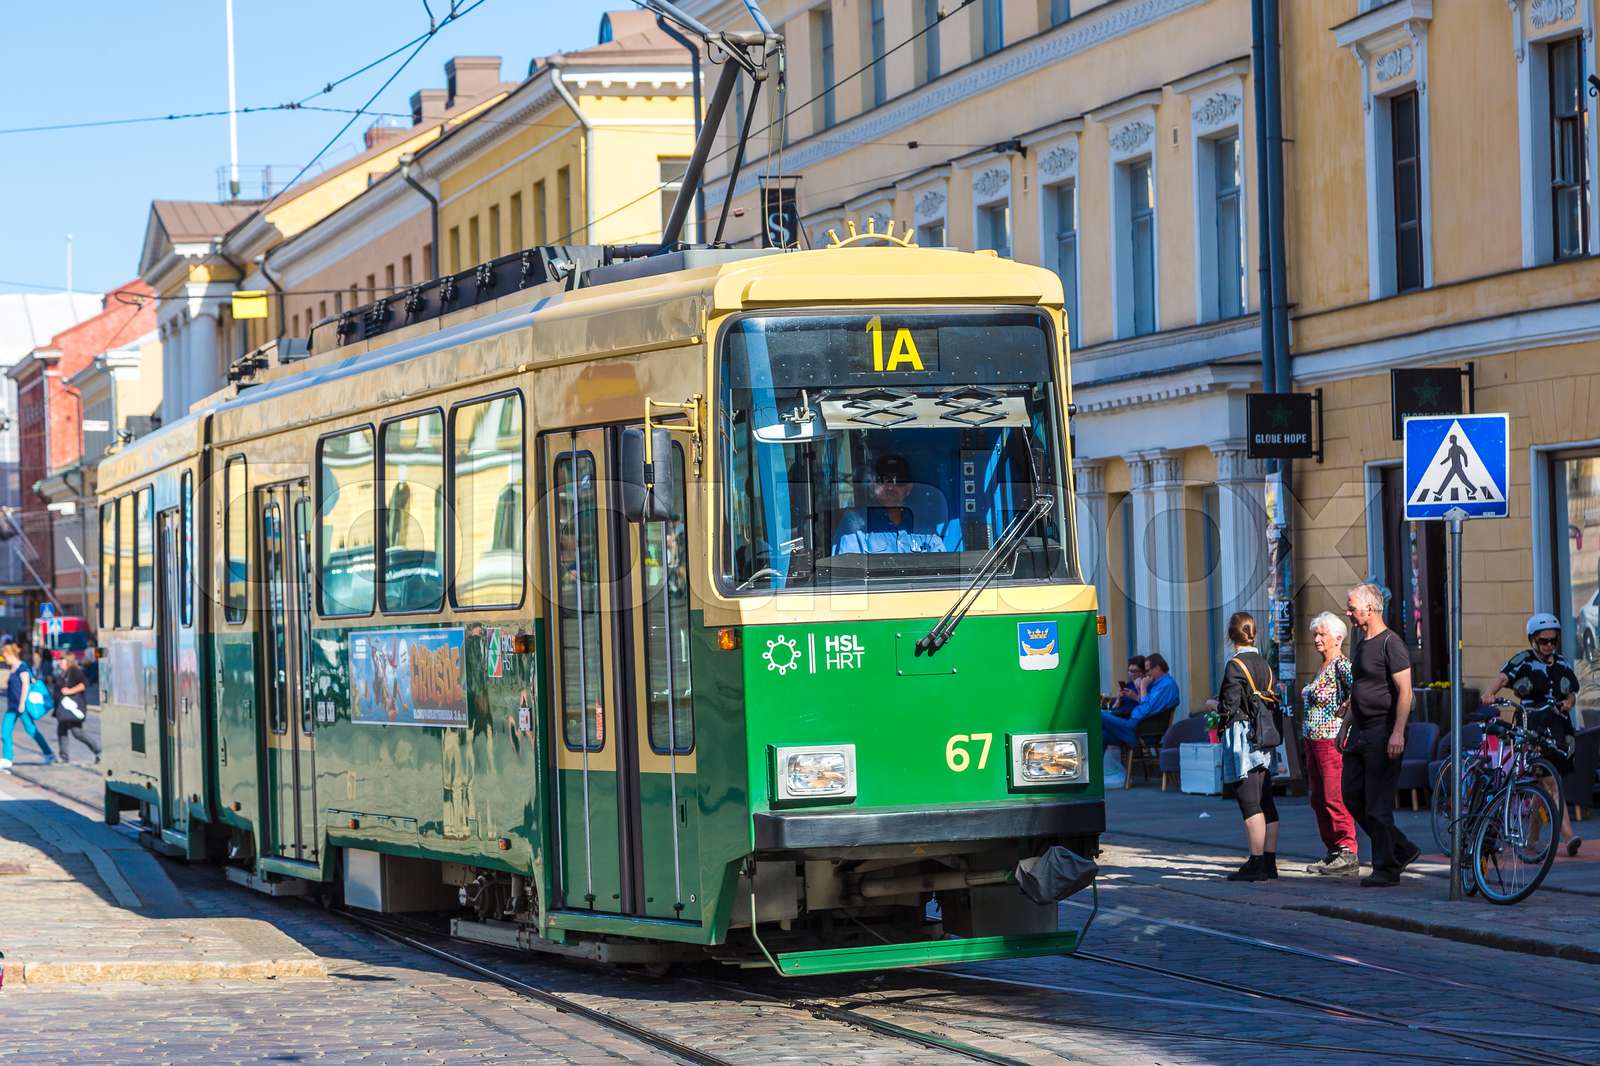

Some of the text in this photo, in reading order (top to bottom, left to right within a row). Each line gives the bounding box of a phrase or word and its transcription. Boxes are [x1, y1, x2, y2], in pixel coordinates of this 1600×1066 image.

[865, 315, 925, 372] 1A
[1255, 433, 1308, 444] GLOBE HOPE
[825, 634, 865, 652] HSL
[826, 651, 865, 670] HRT
[945, 732, 993, 773] 67
